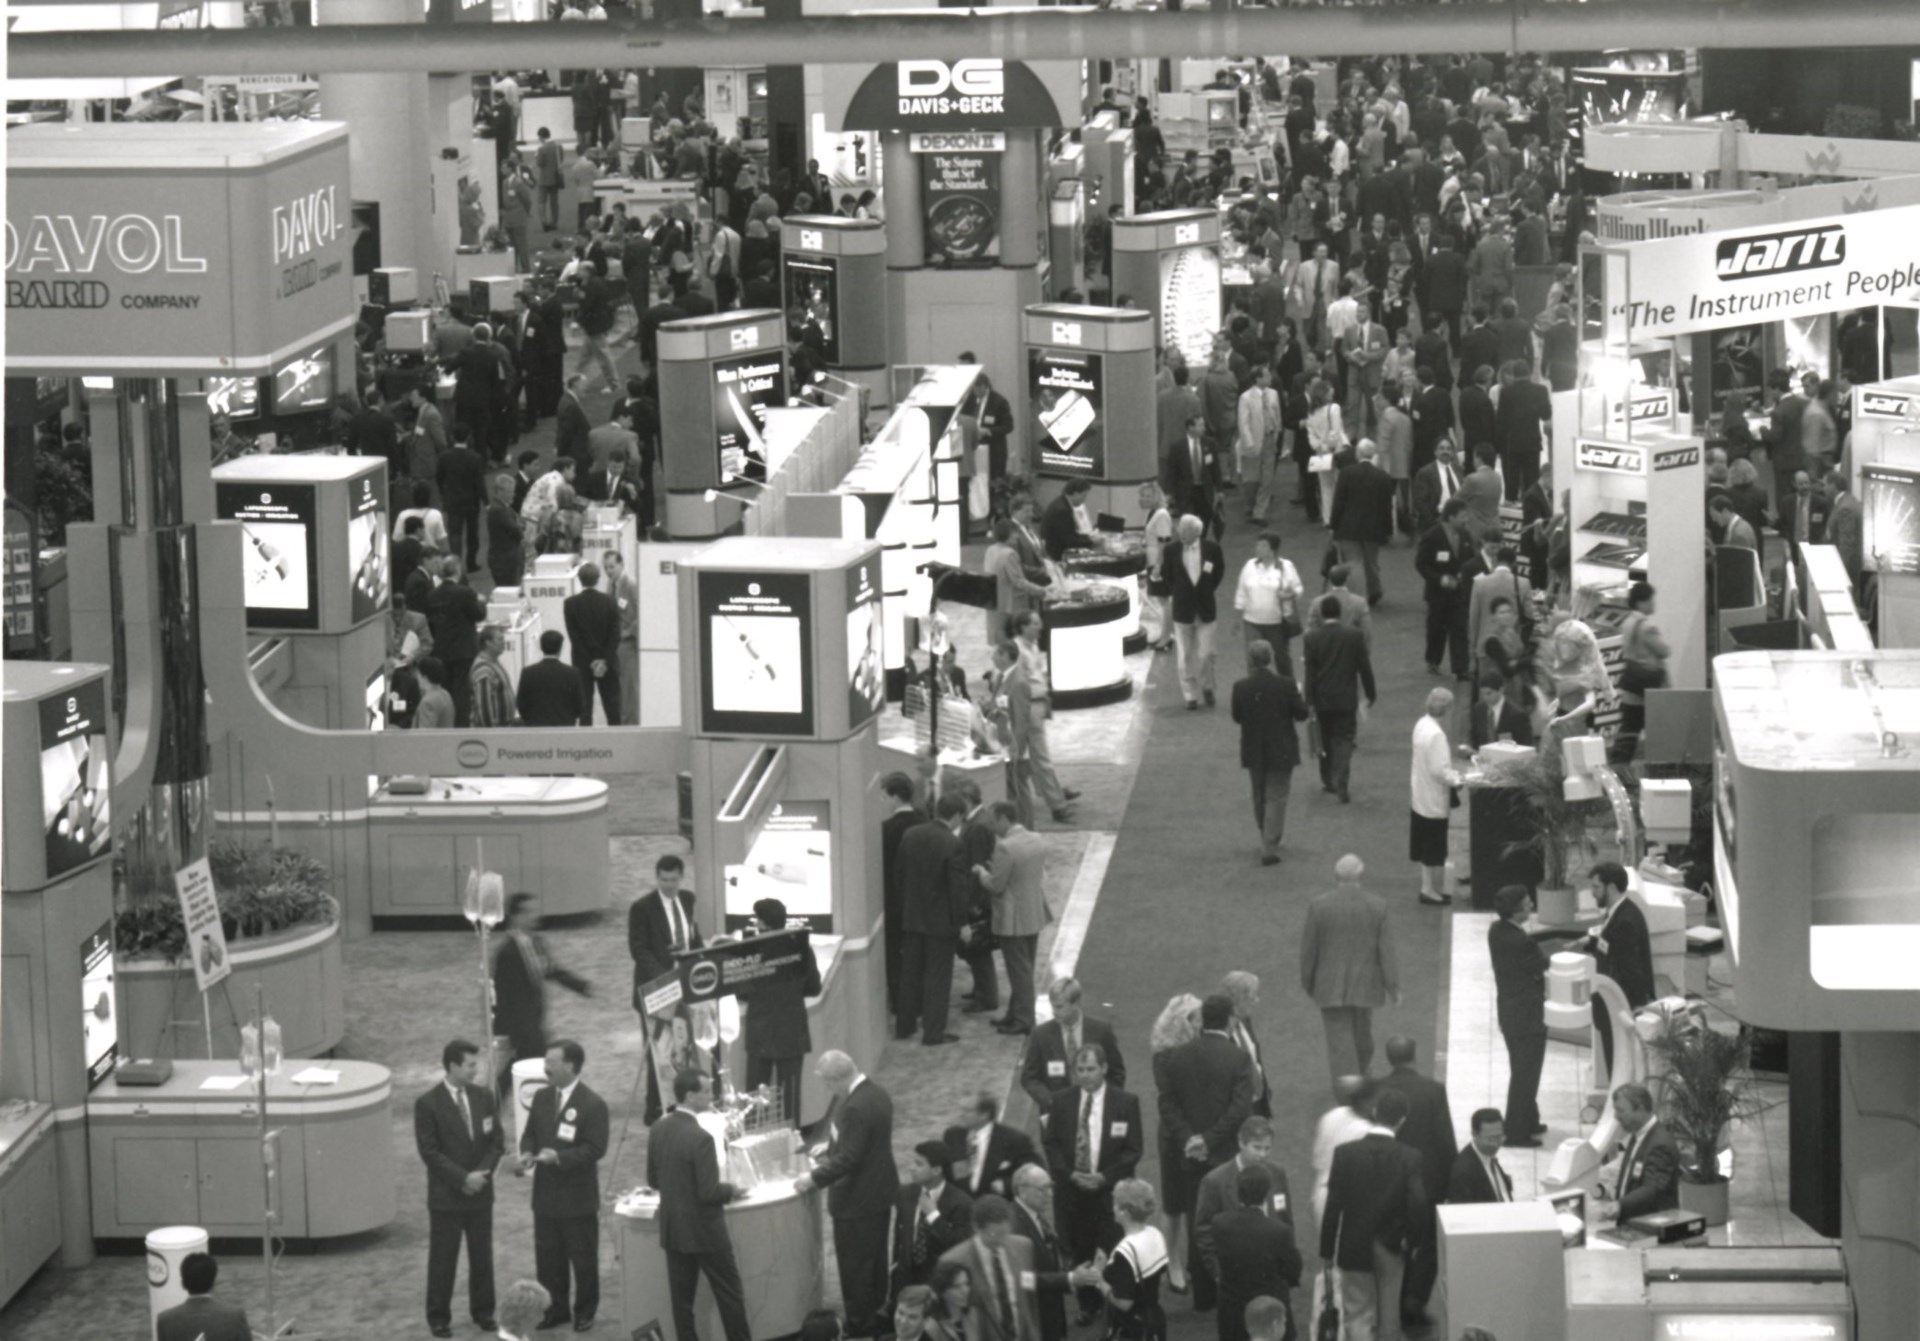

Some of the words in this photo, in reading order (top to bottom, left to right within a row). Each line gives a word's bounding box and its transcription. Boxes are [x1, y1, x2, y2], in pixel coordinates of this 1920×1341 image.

[898, 58, 1004, 96] DG
[898, 97, 1004, 115] DAVIS+GECK
[920, 135, 979, 150] DEXON
[934, 157, 951, 168] The
[273, 185, 344, 265] DAVOL
[121, 295, 200, 309] COMPANY
[1689, 280, 1833, 320] Instrument
[530, 586, 566, 598] ERBE
[497, 747, 552, 761] Powered
[556, 747, 613, 762] Irrigation
